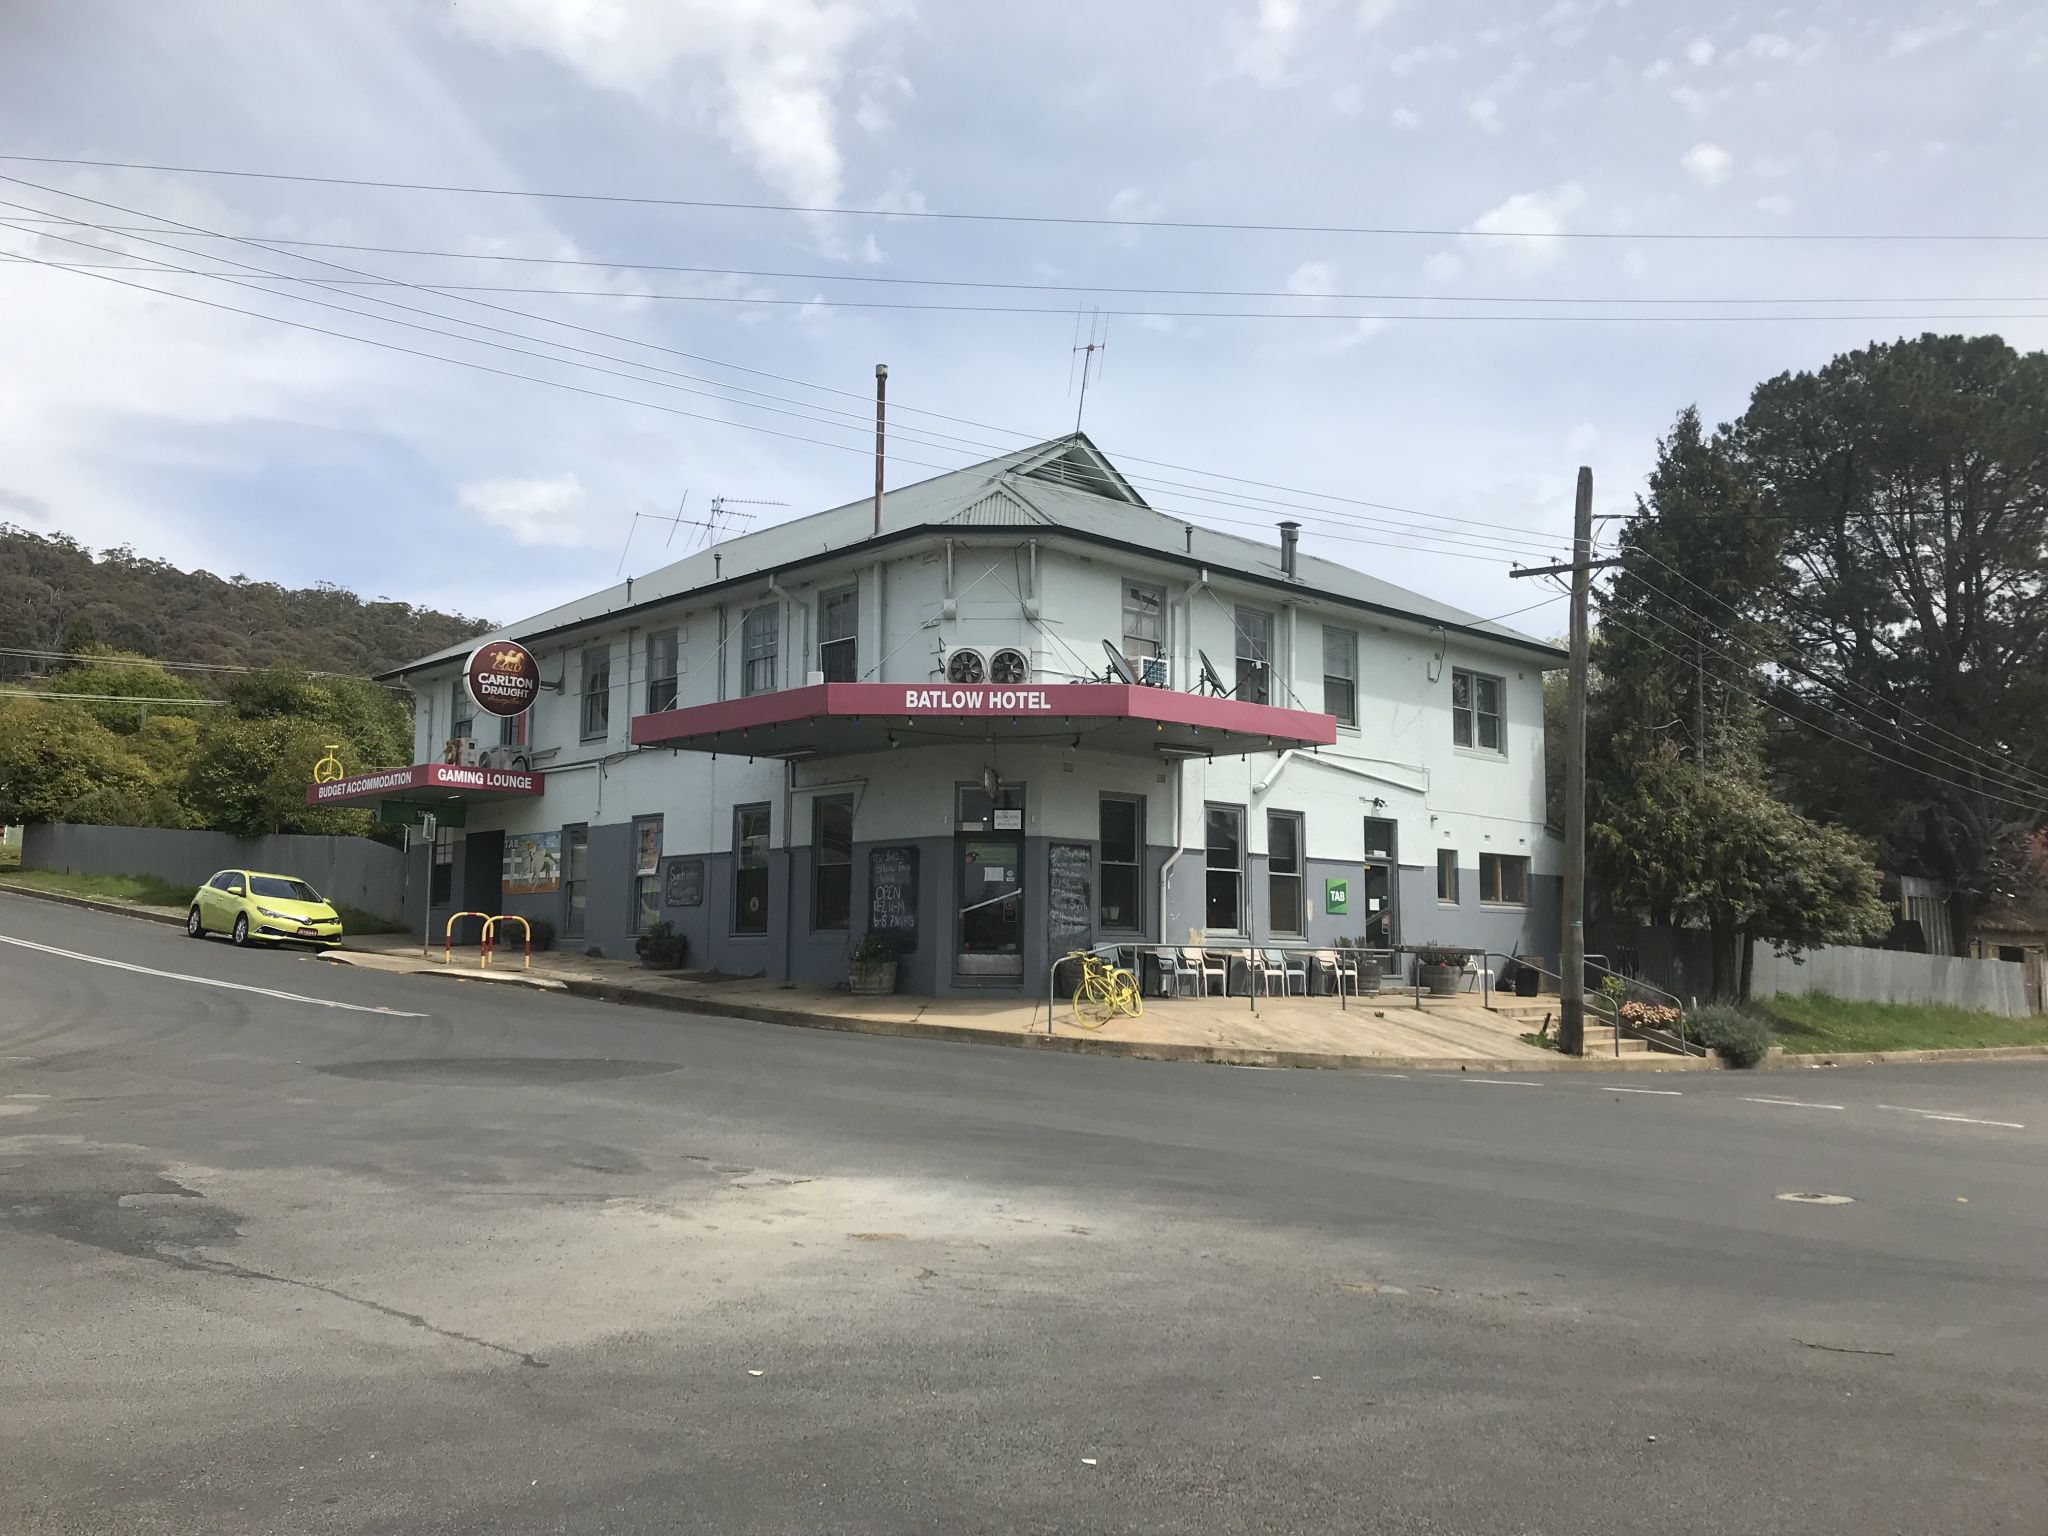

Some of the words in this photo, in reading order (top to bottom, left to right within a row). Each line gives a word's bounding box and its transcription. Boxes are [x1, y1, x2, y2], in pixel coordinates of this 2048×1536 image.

[478, 672, 533, 689] CARLTON
[481, 684, 529, 698] DRAUGHT
[905, 690, 984, 709] BATLOW
[988, 691, 1051, 709] HOTEL
[318, 782, 346, 798] BUDGET
[346, 771, 412, 794] ACCOMMODATION
[437, 768, 484, 785] GAMING
[486, 775, 532, 789] LOUNGE
[875, 885, 900, 901] OPEN
[1330, 890, 1345, 902] TAB
